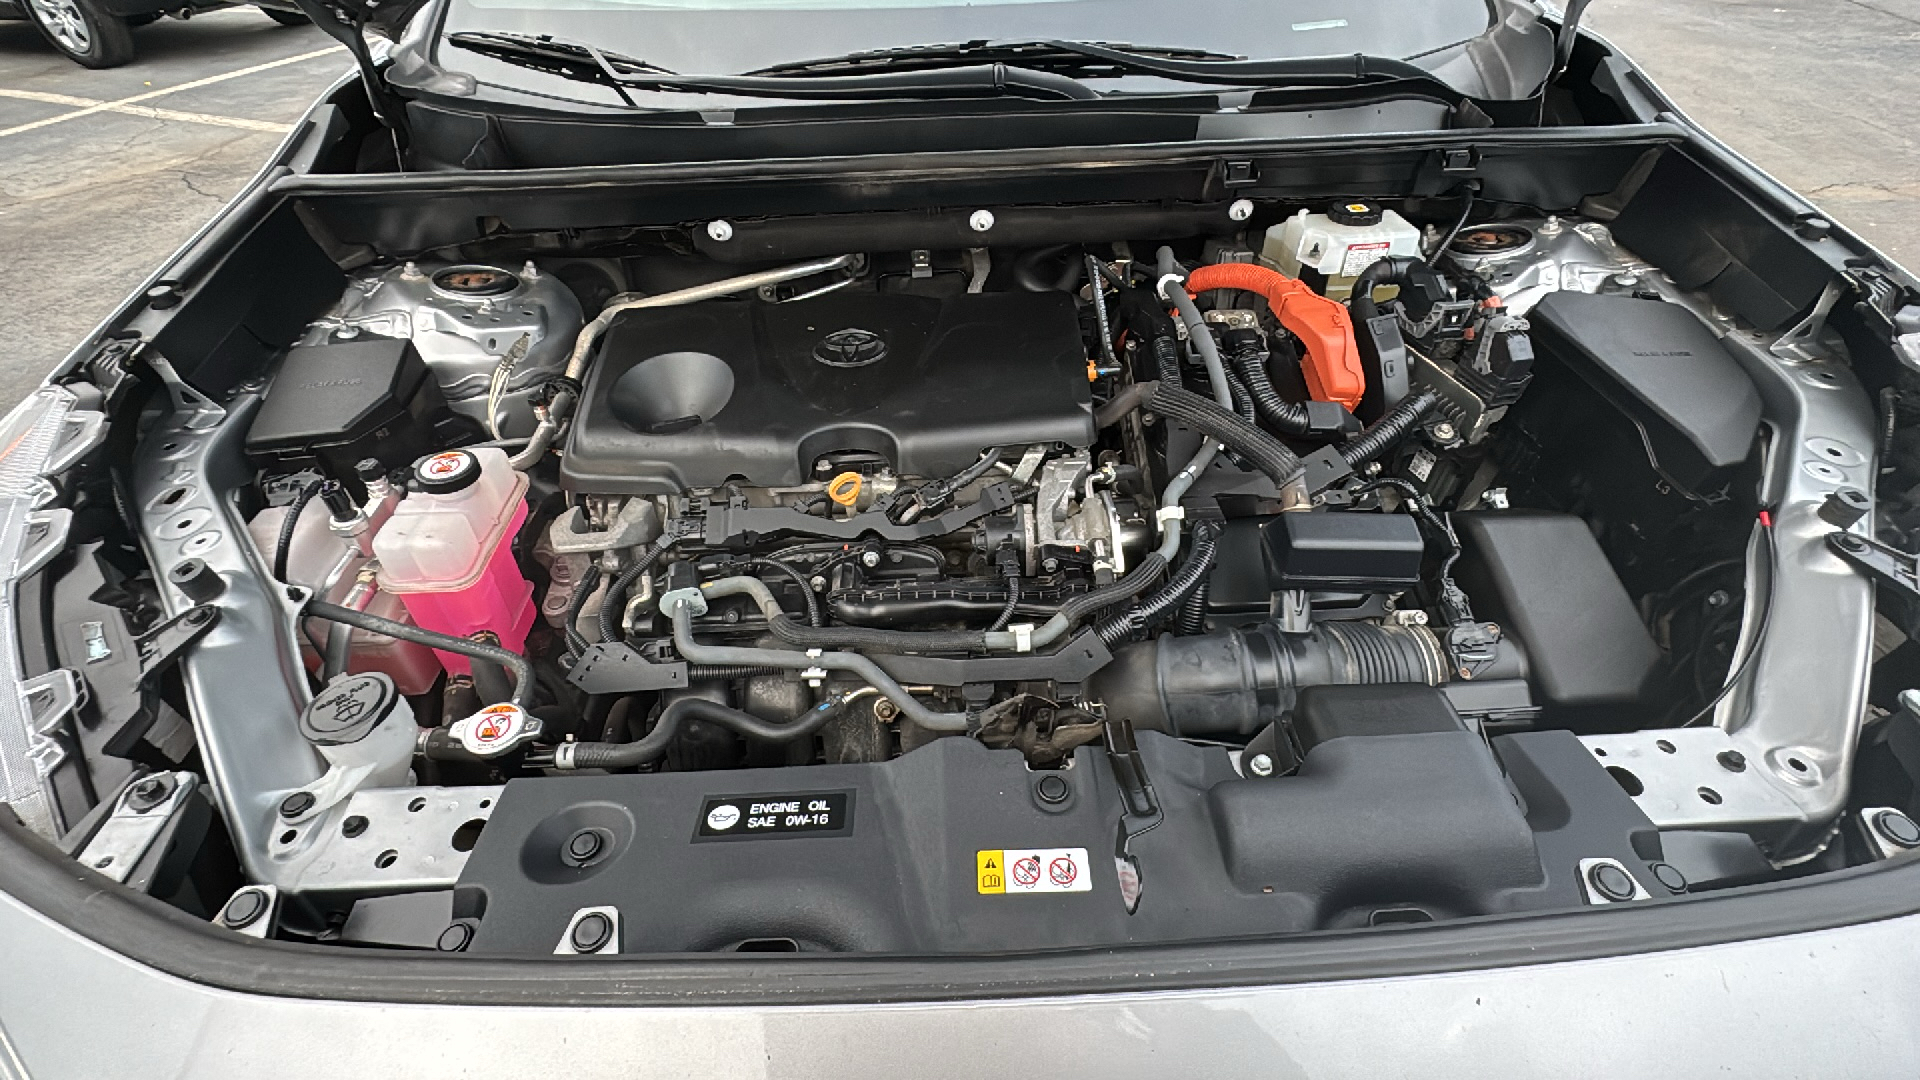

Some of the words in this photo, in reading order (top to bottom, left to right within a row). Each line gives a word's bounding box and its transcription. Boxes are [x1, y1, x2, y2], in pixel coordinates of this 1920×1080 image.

[749, 802, 801, 815] ENGINE
[807, 800, 831, 812] OIL
[747, 815, 777, 828] SAE
[785, 813, 829, 827] 0W-16
